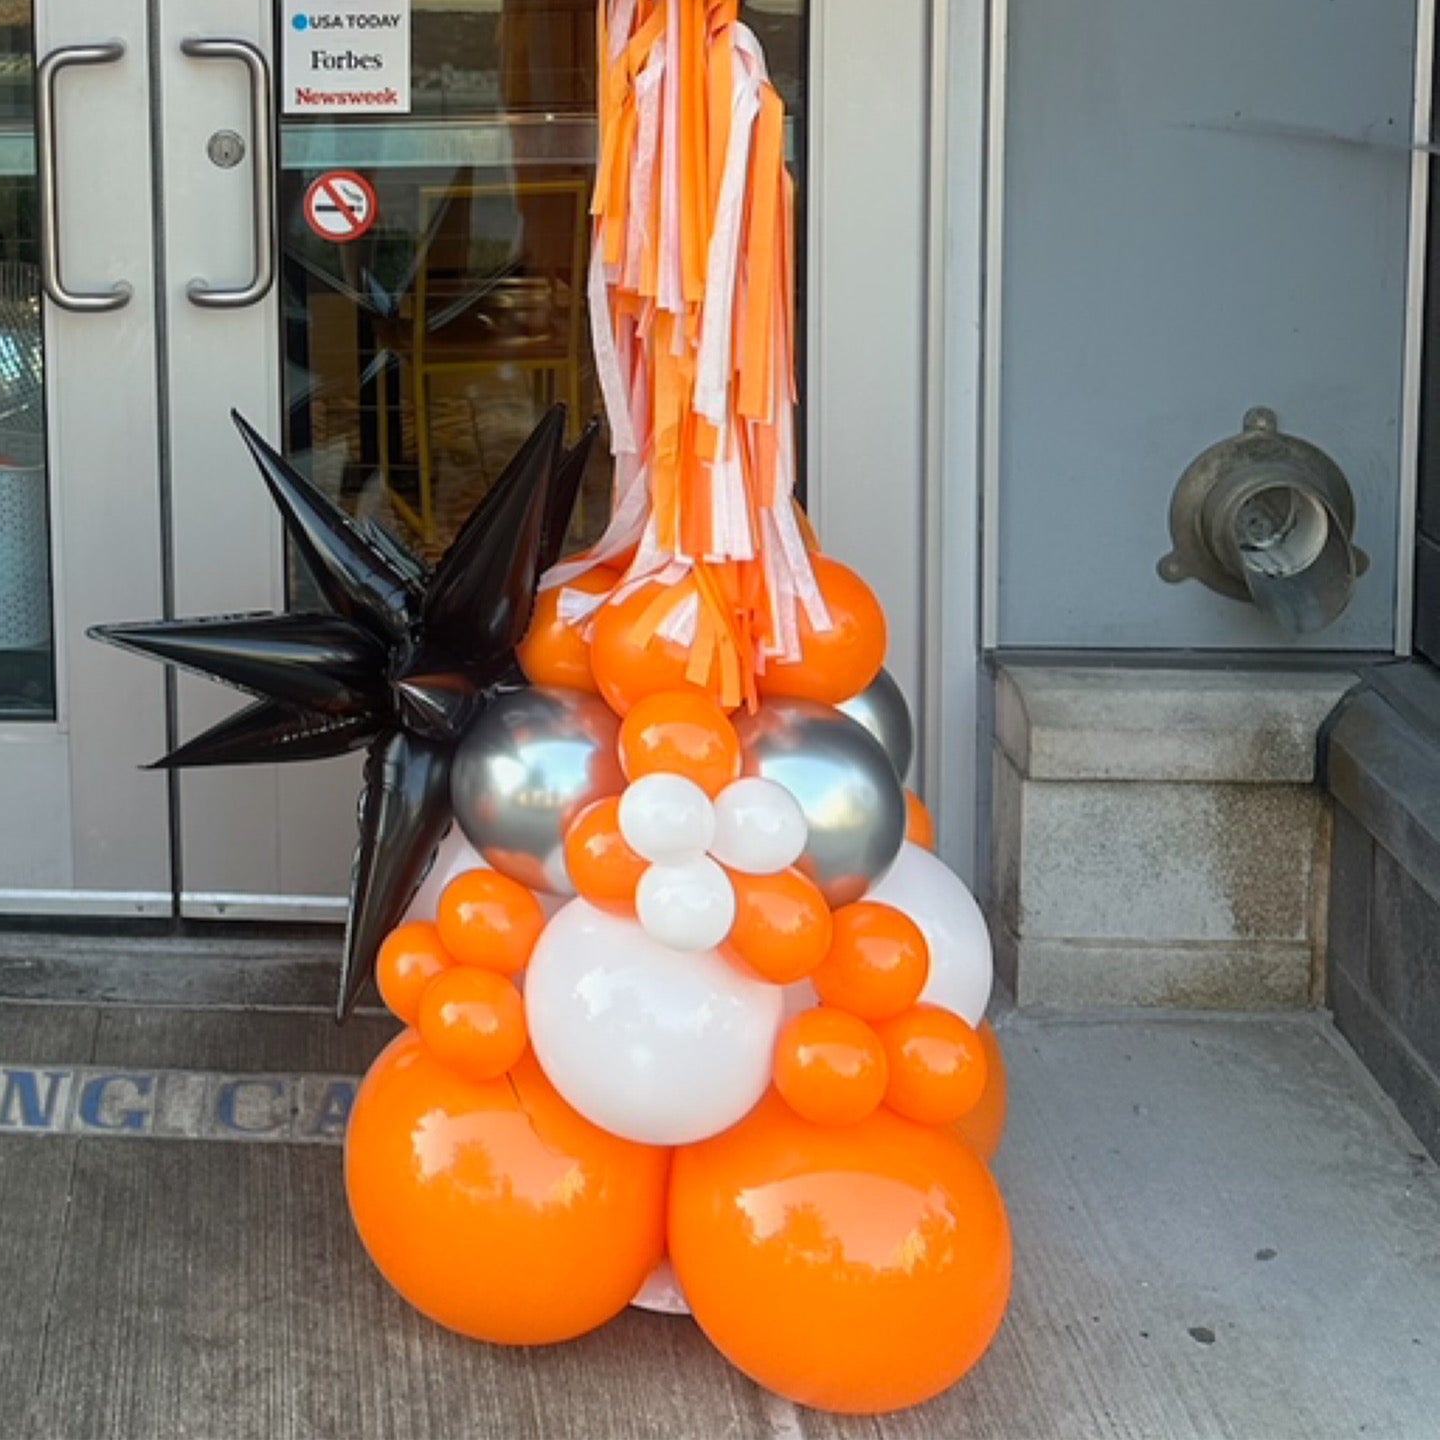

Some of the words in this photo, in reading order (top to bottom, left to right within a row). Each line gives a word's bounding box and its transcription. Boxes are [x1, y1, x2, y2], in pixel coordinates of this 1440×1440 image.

[310, 15, 343, 30] USA
[347, 14, 401, 30] TODAY
[311, 50, 383, 71] Forbes
[295, 87, 398, 106] Newsweek
